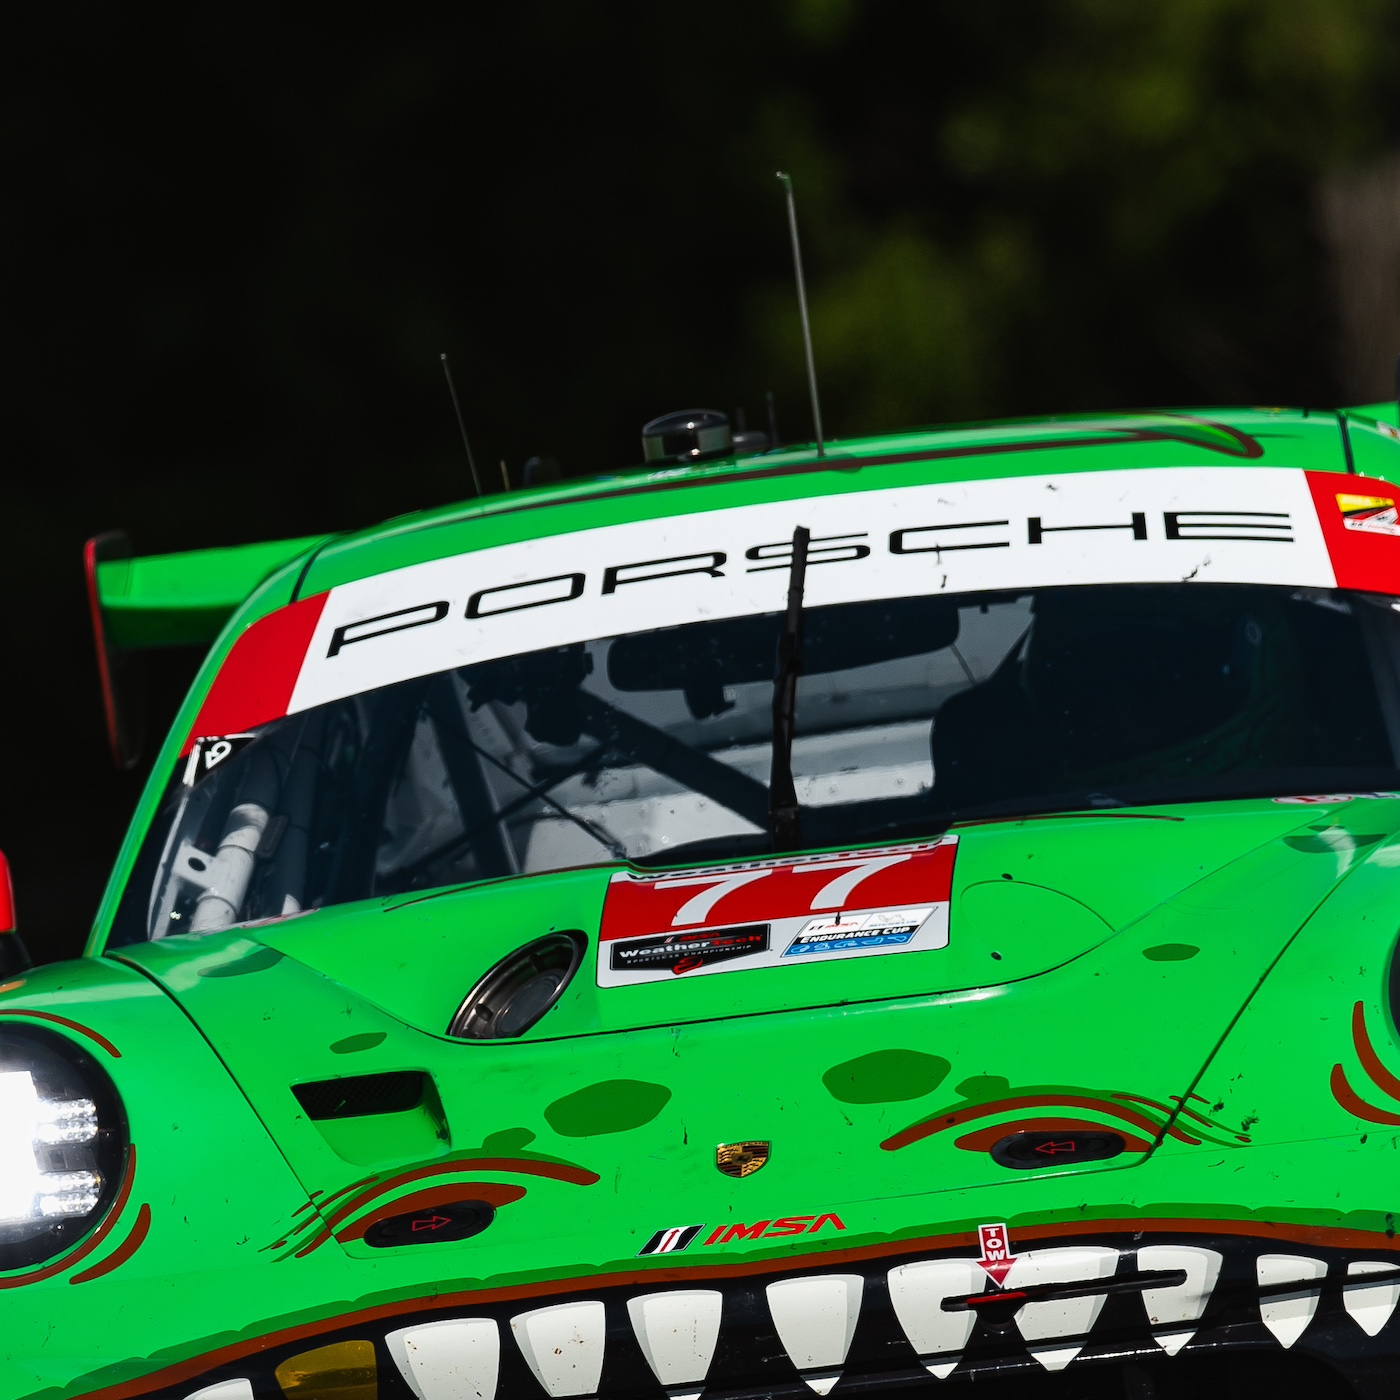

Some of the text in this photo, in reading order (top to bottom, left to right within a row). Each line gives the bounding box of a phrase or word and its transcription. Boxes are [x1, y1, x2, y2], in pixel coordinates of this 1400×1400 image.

[325, 511, 1296, 660] PORSCHE
[654, 854, 912, 927] 77
[619, 934, 762, 958] WeatherTech
[800, 926, 911, 944] ENDURANCE CUP
[703, 1212, 848, 1247] IMSA
[985, 1227, 1006, 1261] TOW
